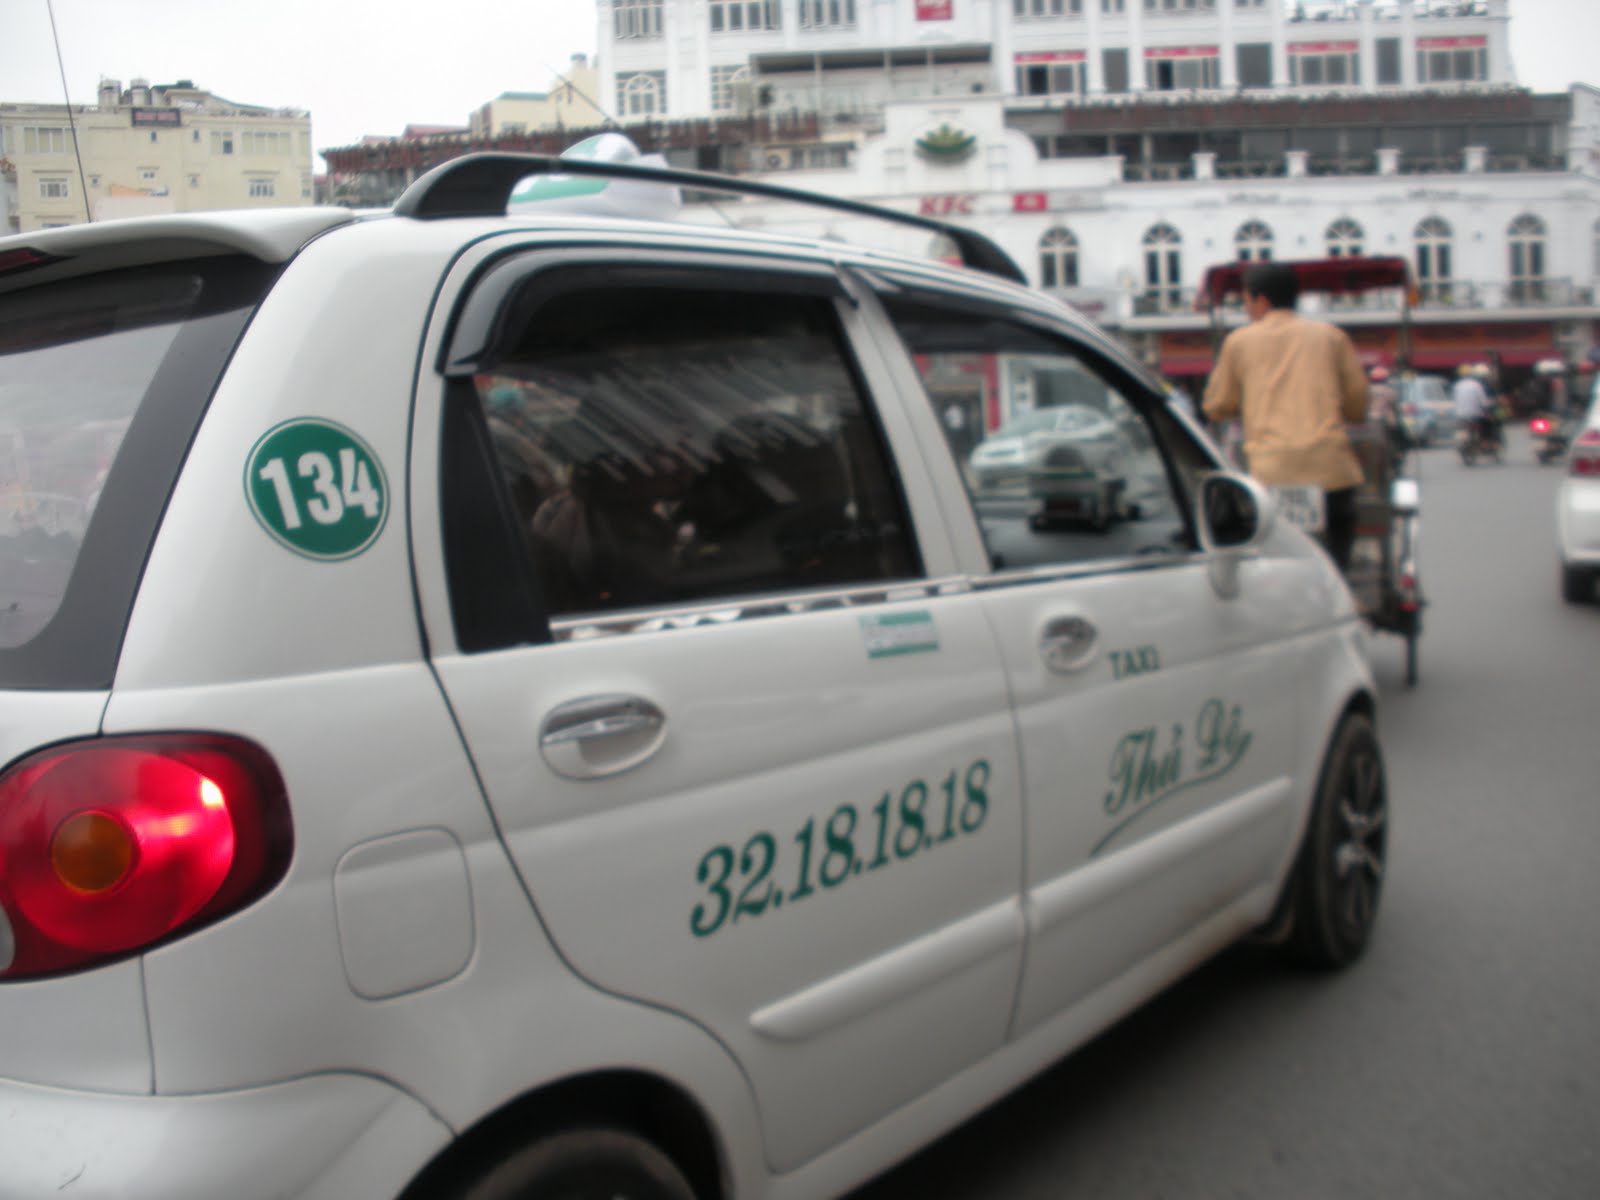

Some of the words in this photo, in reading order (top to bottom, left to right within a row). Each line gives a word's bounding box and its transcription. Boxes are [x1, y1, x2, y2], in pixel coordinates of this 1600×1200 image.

[919, 195, 976, 216] KFC
[259, 448, 379, 529] 134
[1108, 645, 1161, 680] TAXI
[690, 758, 991, 938] 32.18.18.18
